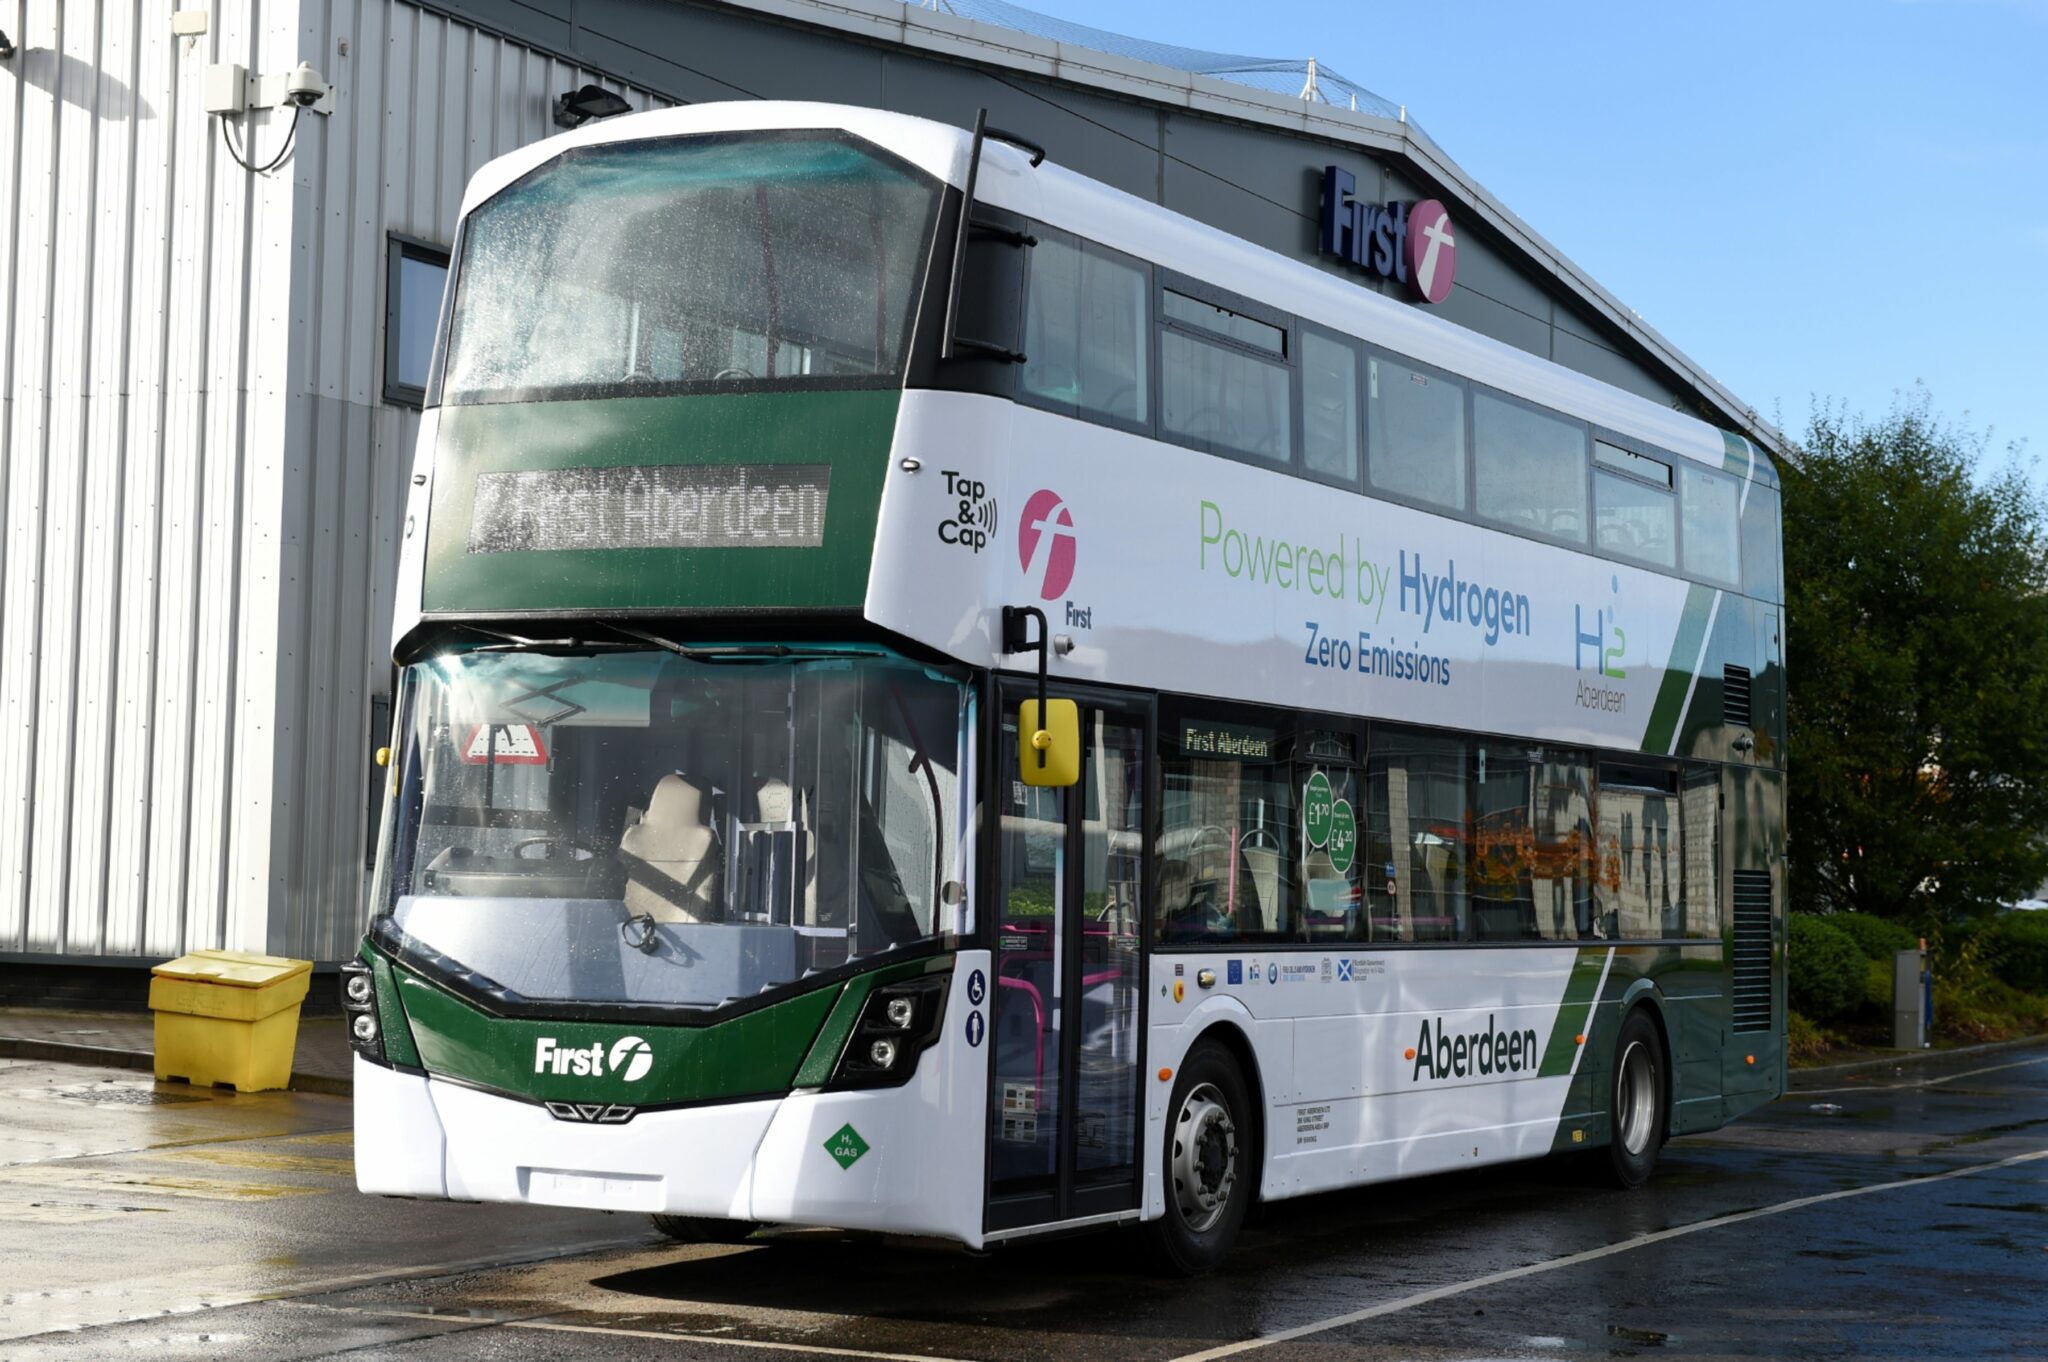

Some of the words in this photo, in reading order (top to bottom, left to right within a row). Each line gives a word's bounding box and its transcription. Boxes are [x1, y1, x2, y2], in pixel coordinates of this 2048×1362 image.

[1324, 165, 1408, 284] First
[624, 467, 820, 541] Aberdeen
[941, 470, 985, 504] Tap
[958, 500, 976, 525] &
[938, 519, 986, 554] Cap
[1200, 499, 1344, 600] Powered
[1357, 537, 1390, 625] by
[1399, 549, 1530, 646] Hydrogen
[1065, 600, 1092, 630] First
[1305, 621, 1351, 671] Zero
[1358, 631, 1450, 686] Emissions
[1575, 678, 1626, 714] Aberdeen
[1186, 728, 1214, 752] First
[1218, 731, 1268, 757] Aberdeen
[535, 1037, 604, 1076] First
[1412, 1013, 1537, 1082] Aberdeen
[834, 1146, 858, 1158] GAS
